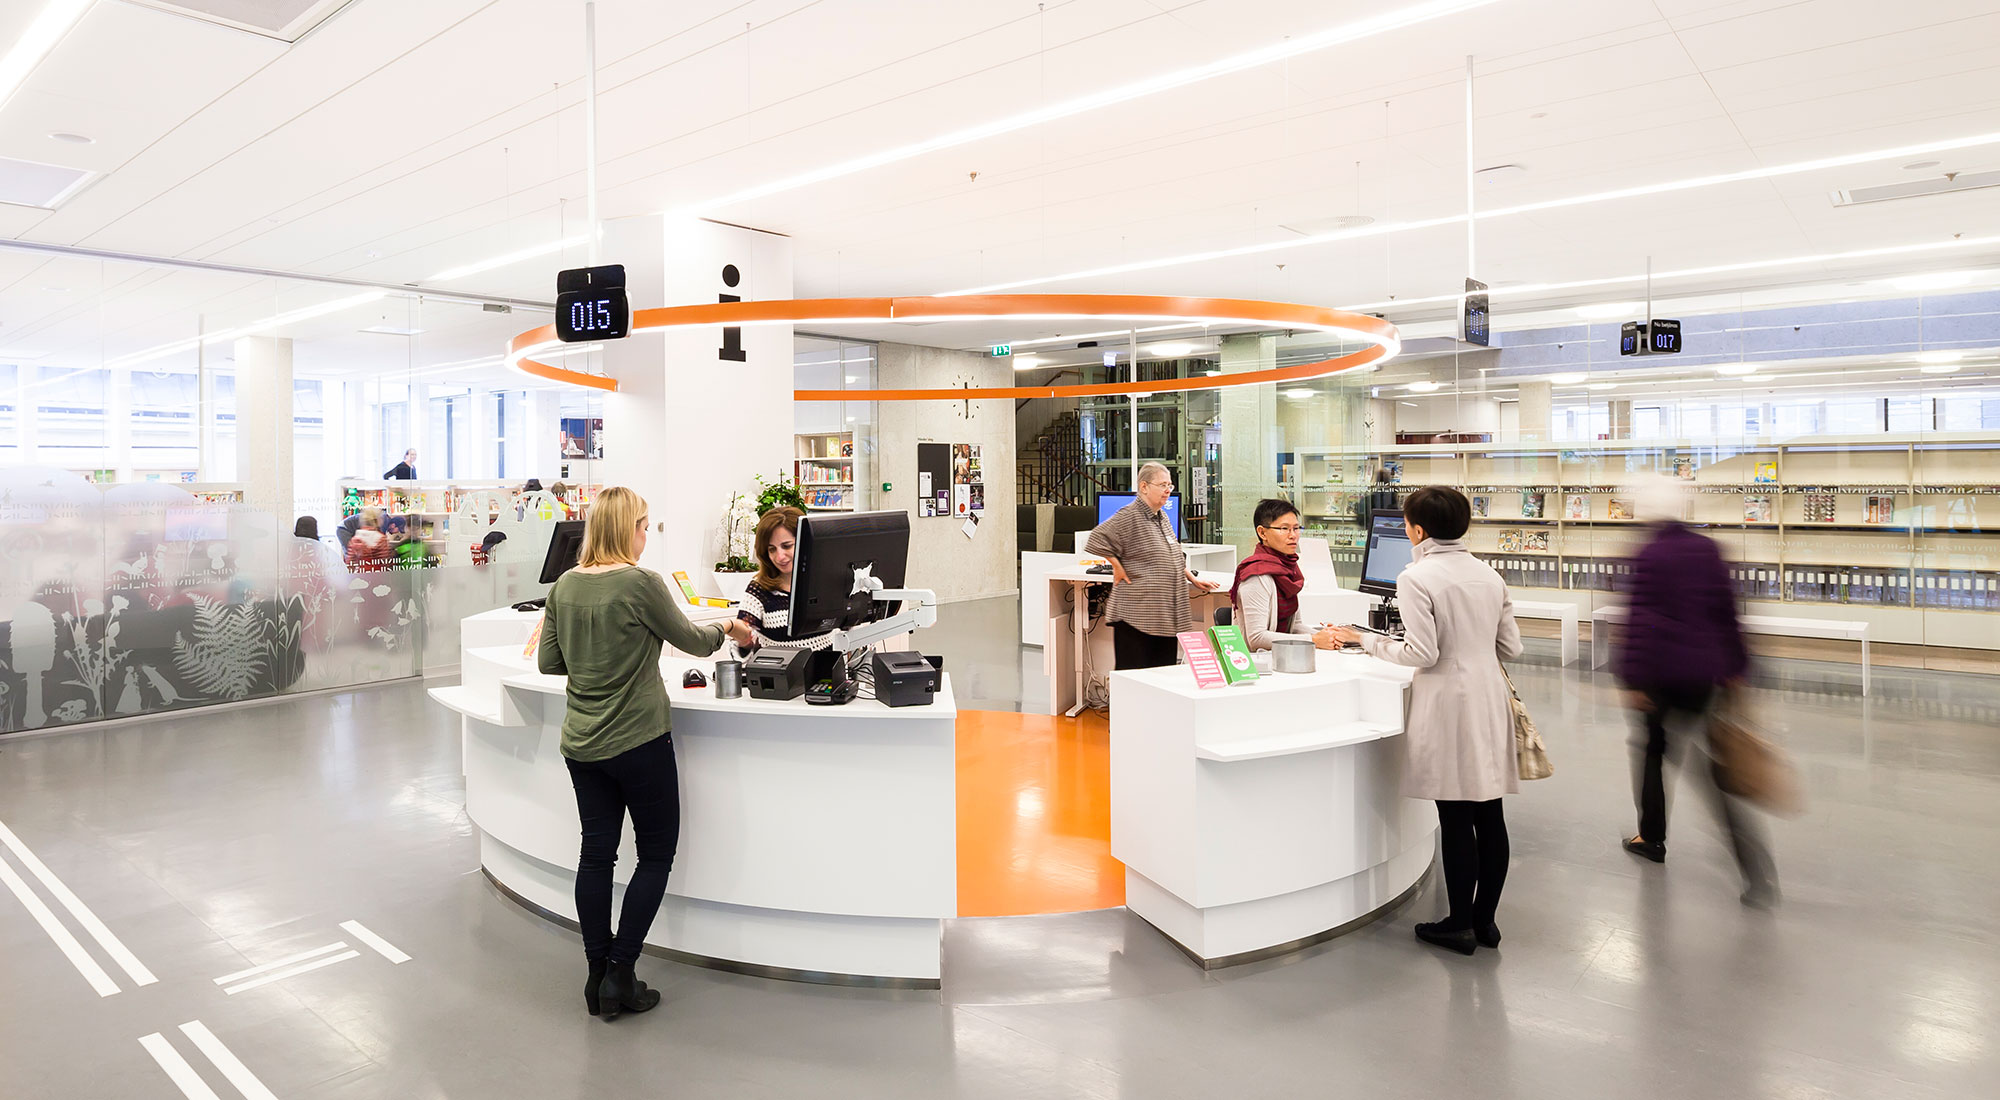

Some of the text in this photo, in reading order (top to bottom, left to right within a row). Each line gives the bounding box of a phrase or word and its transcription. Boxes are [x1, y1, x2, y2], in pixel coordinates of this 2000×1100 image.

[587, 273, 592, 284] 1
[571, 300, 610, 331] 015
[719, 264, 746, 362] i
[1656, 333, 1675, 348] 017
